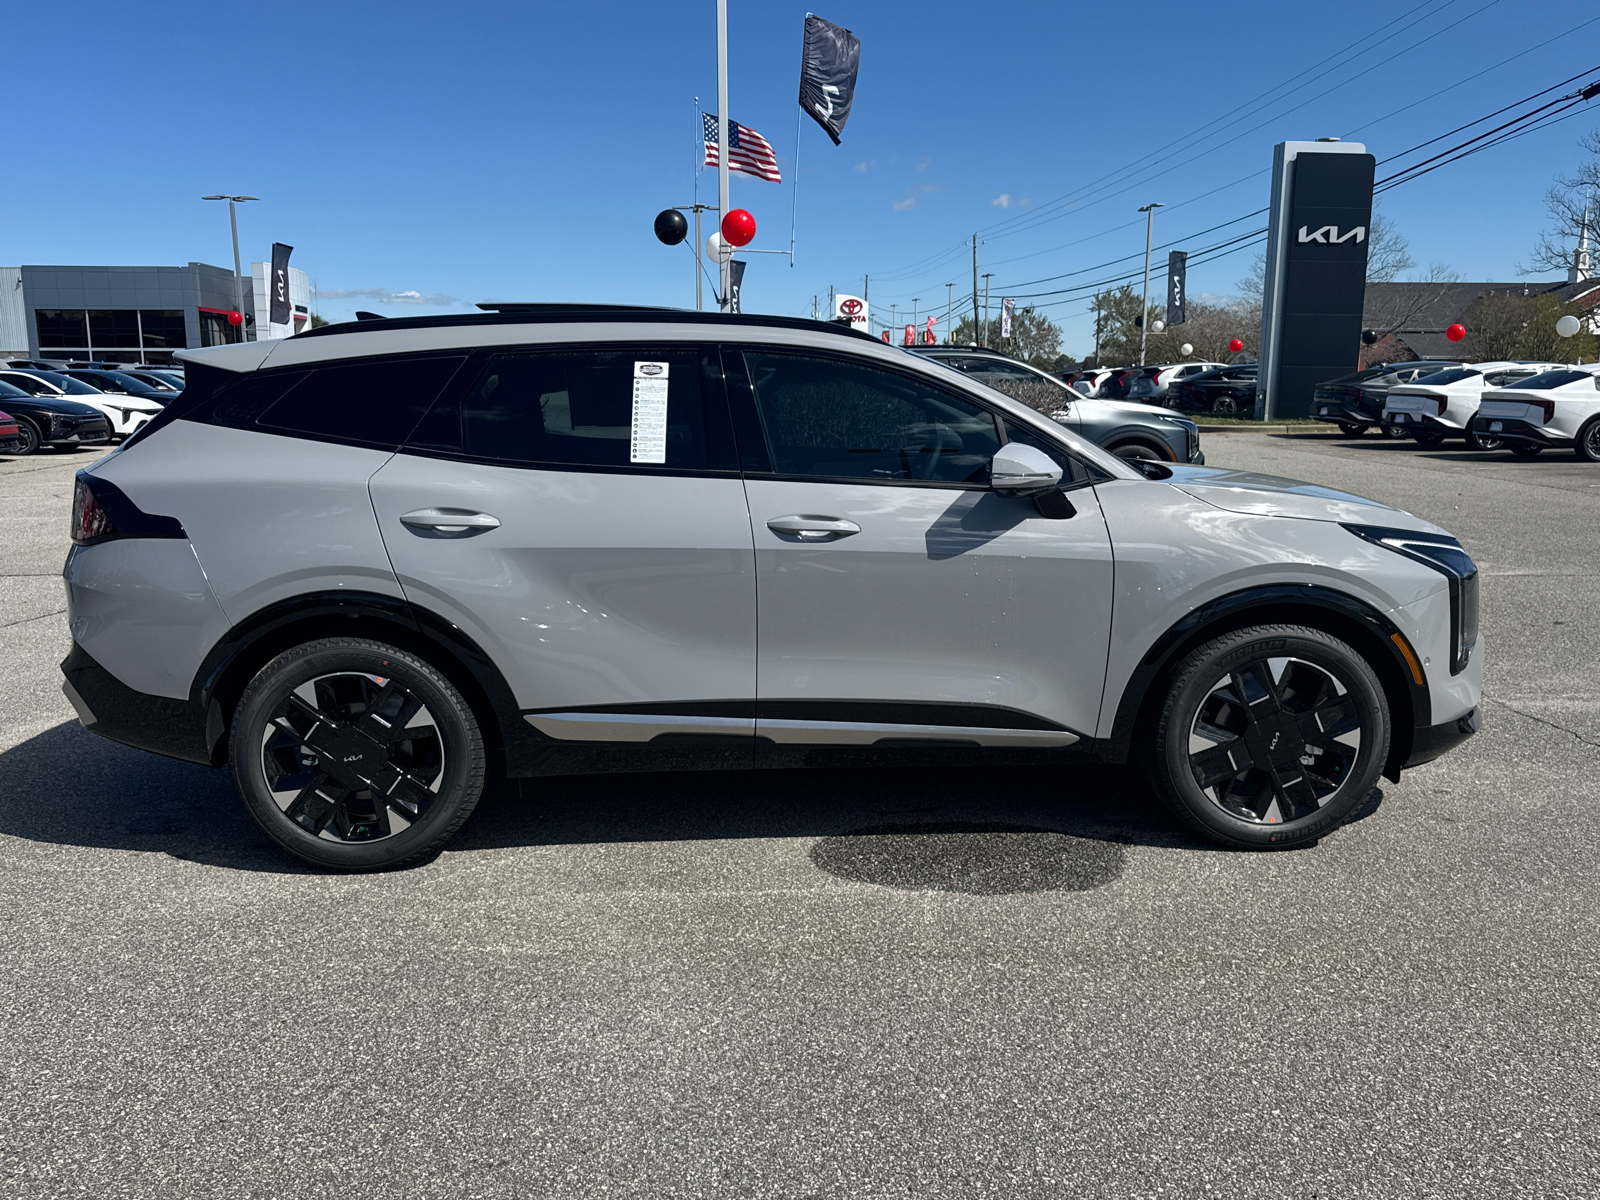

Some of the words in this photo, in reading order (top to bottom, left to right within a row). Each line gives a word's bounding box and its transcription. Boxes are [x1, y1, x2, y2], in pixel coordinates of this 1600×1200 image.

[1297, 225, 1366, 244] KIA
[277, 269, 285, 302] KIA
[1173, 275, 1181, 306] KIA
[1220, 640, 1285, 666] MICHELIN
[1269, 731, 1280, 750] KIA
[343, 754, 363, 763] KIA
